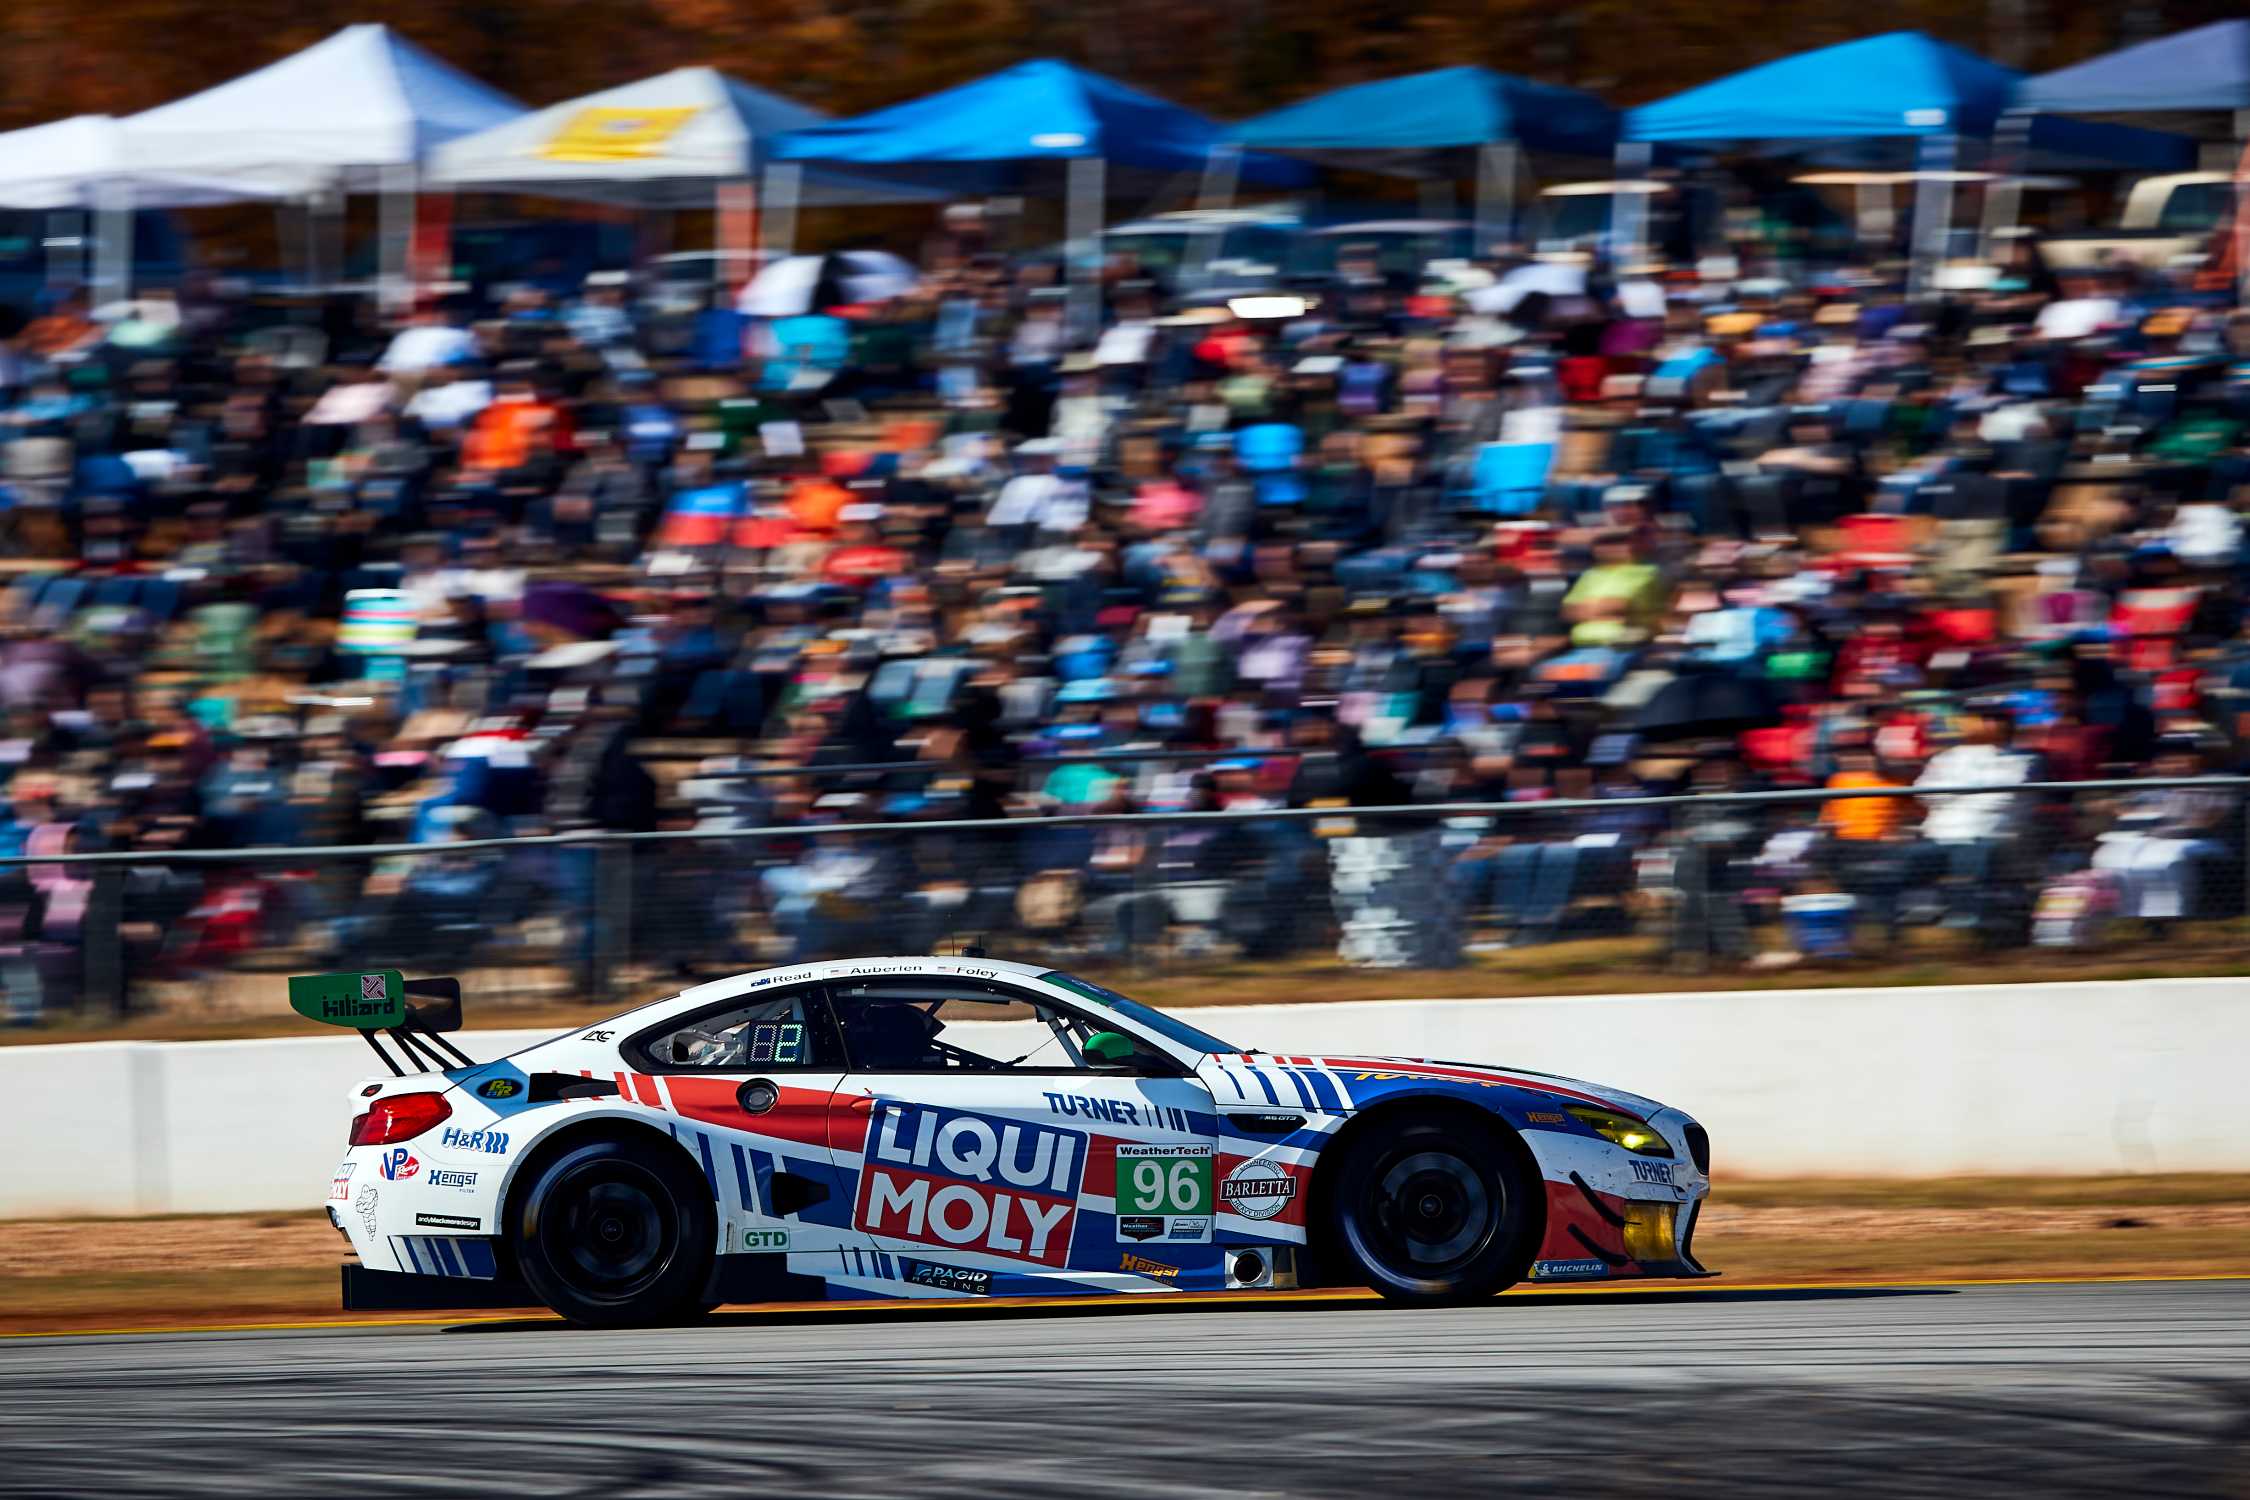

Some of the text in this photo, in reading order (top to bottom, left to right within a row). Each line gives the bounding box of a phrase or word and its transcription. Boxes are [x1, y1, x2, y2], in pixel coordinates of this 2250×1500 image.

[773, 971, 812, 984] Read
[850, 965, 923, 975] Auberlen
[957, 966, 999, 979] Foley
[1042, 1092, 1140, 1127] TURNER
[442, 1127, 484, 1150] H&R
[877, 1106, 1076, 1192] LIQUI
[383, 1148, 408, 1181] VP
[1628, 1159, 1674, 1185] TURNER
[428, 1169, 478, 1187] Hengst
[1133, 1159, 1200, 1211] 96
[1225, 1180, 1291, 1197] BARLETTA
[866, 1171, 1073, 1259] MOLY
[744, 1231, 788, 1247] GTD
[932, 1266, 989, 1282] PAGID
[1552, 1263, 1604, 1273] MICHELIN
